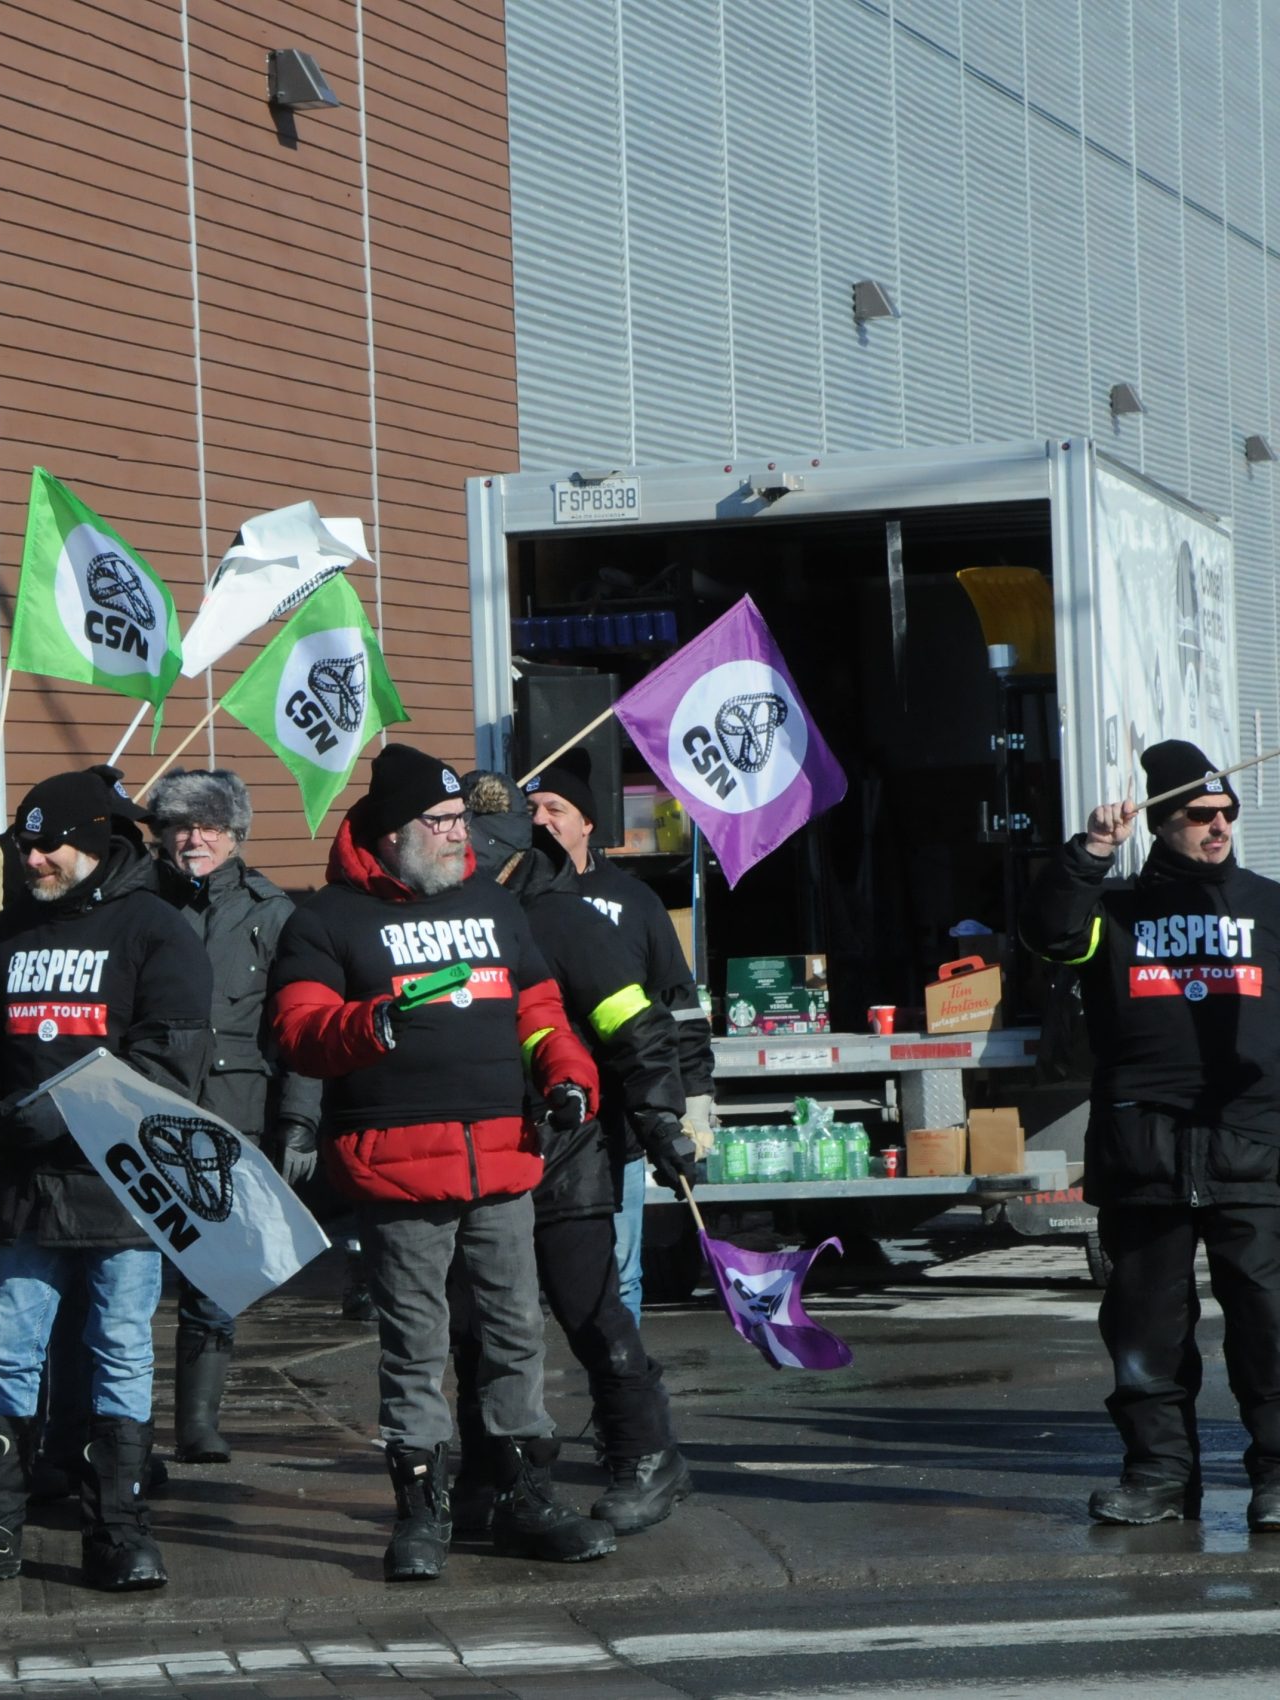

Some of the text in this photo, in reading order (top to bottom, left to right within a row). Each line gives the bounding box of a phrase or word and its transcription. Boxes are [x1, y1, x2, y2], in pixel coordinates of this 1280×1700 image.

[559, 487, 636, 512] FSP8338
[84, 610, 149, 662] CSN
[285, 690, 339, 756] CSN
[682, 725, 738, 800] CSN
[384, 918, 500, 966] RESPECT
[1136, 914, 1254, 958] RESPECT
[7, 949, 110, 993] RESPECT
[947, 982, 972, 999] Tim
[1137, 968, 1193, 981] AVANT
[941, 998, 989, 1016] Hortons
[105, 1142, 202, 1253] CSN
